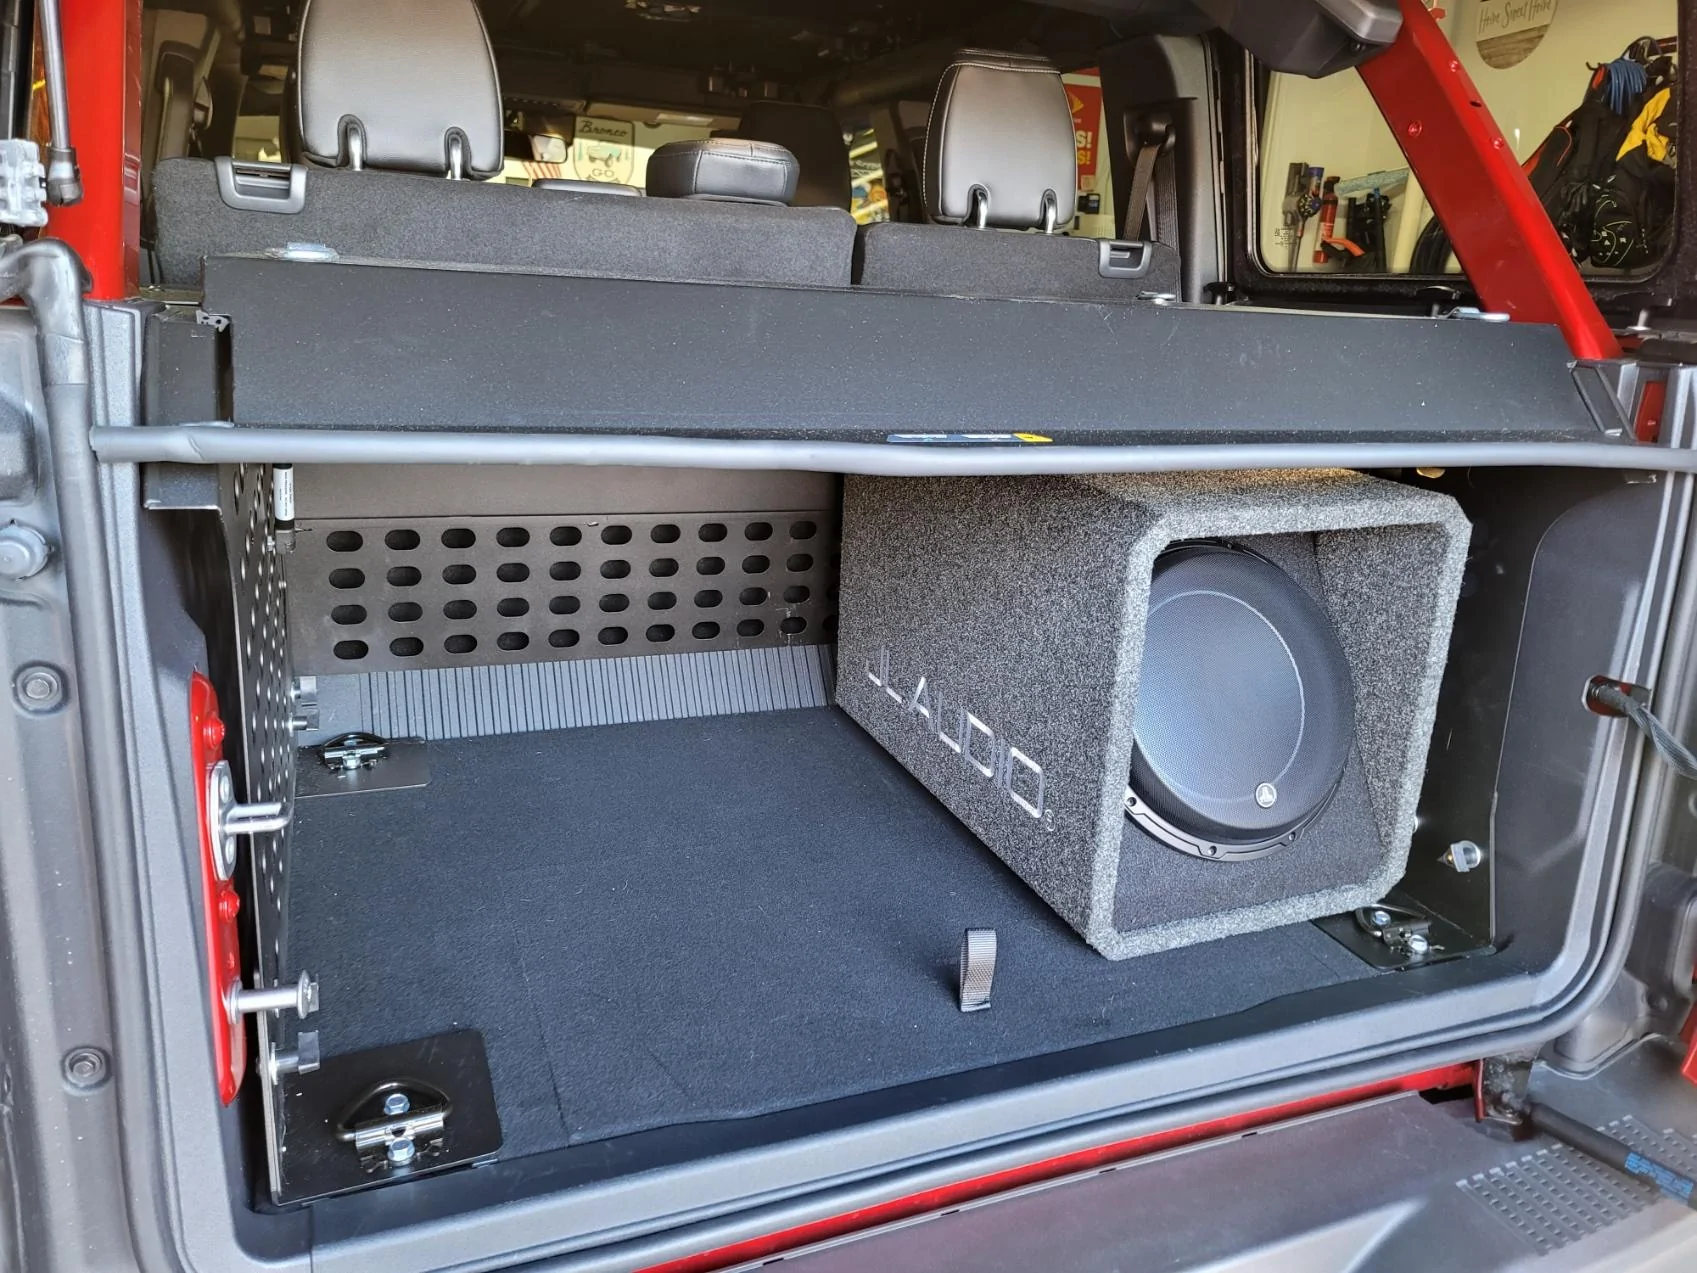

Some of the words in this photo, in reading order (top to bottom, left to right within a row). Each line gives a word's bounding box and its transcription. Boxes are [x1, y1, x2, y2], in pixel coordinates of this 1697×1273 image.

[579, 120, 628, 138] Bronco
[591, 168, 615, 178] GO
[908, 676, 1045, 818] AUDIO
